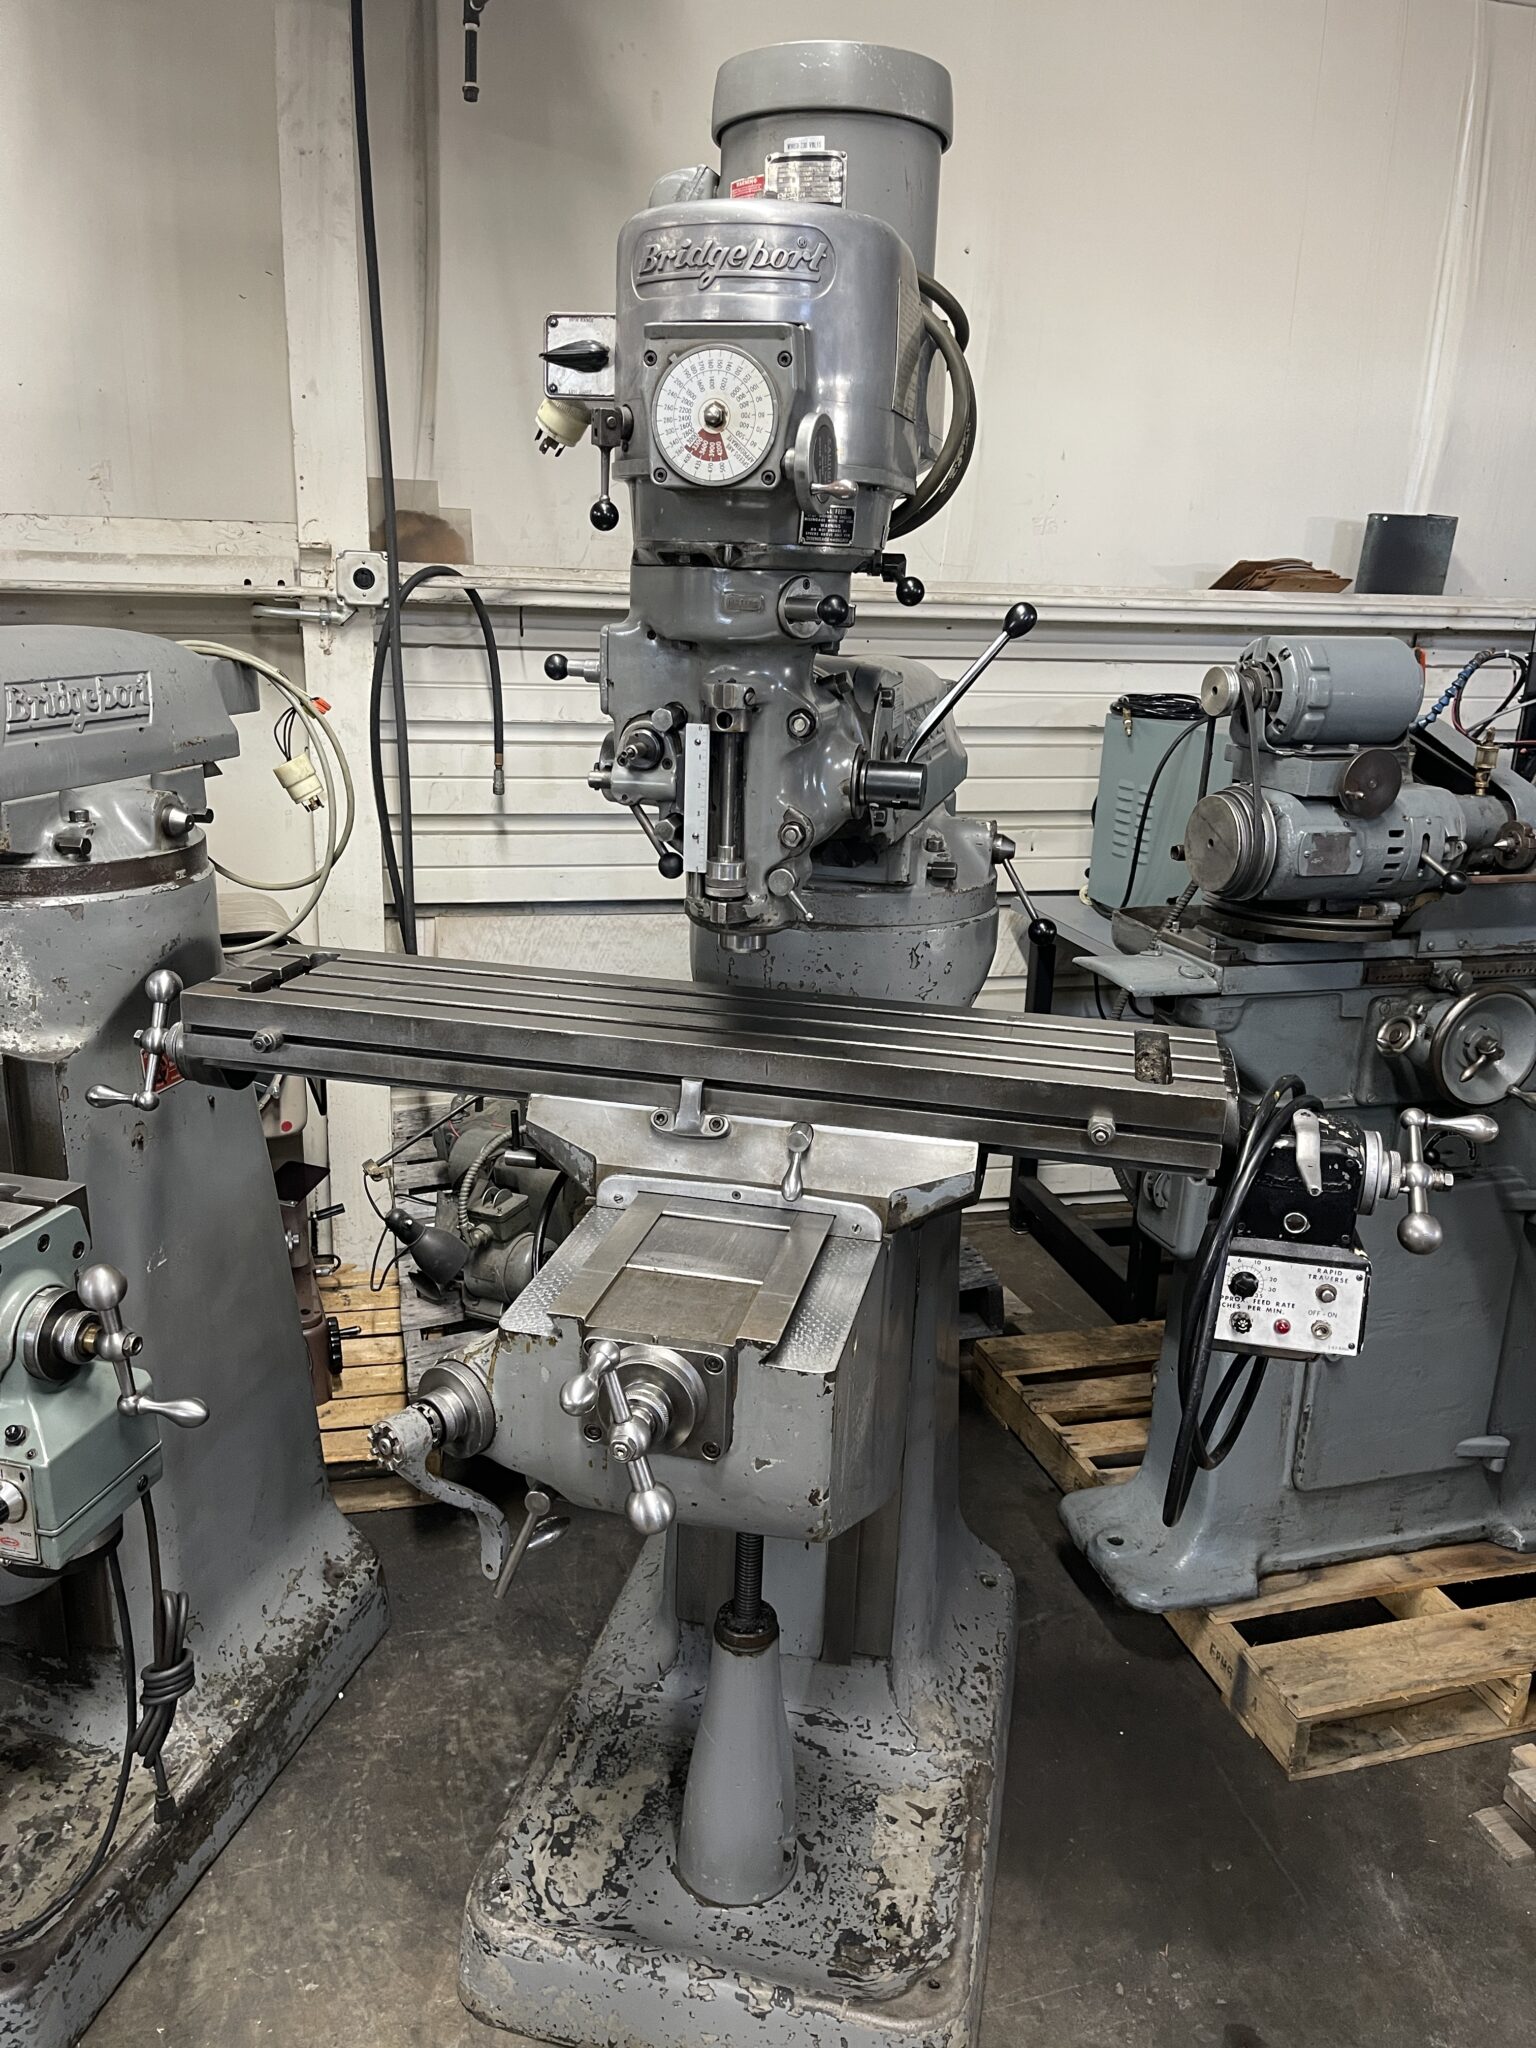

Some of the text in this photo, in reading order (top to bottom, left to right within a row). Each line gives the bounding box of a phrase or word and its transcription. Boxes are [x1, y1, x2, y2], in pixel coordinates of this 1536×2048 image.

[639, 237, 828, 291] Bridgeport
[1316, 1267, 1343, 1276] RAPID
[1308, 1274, 1348, 1284] TRAVERSE
